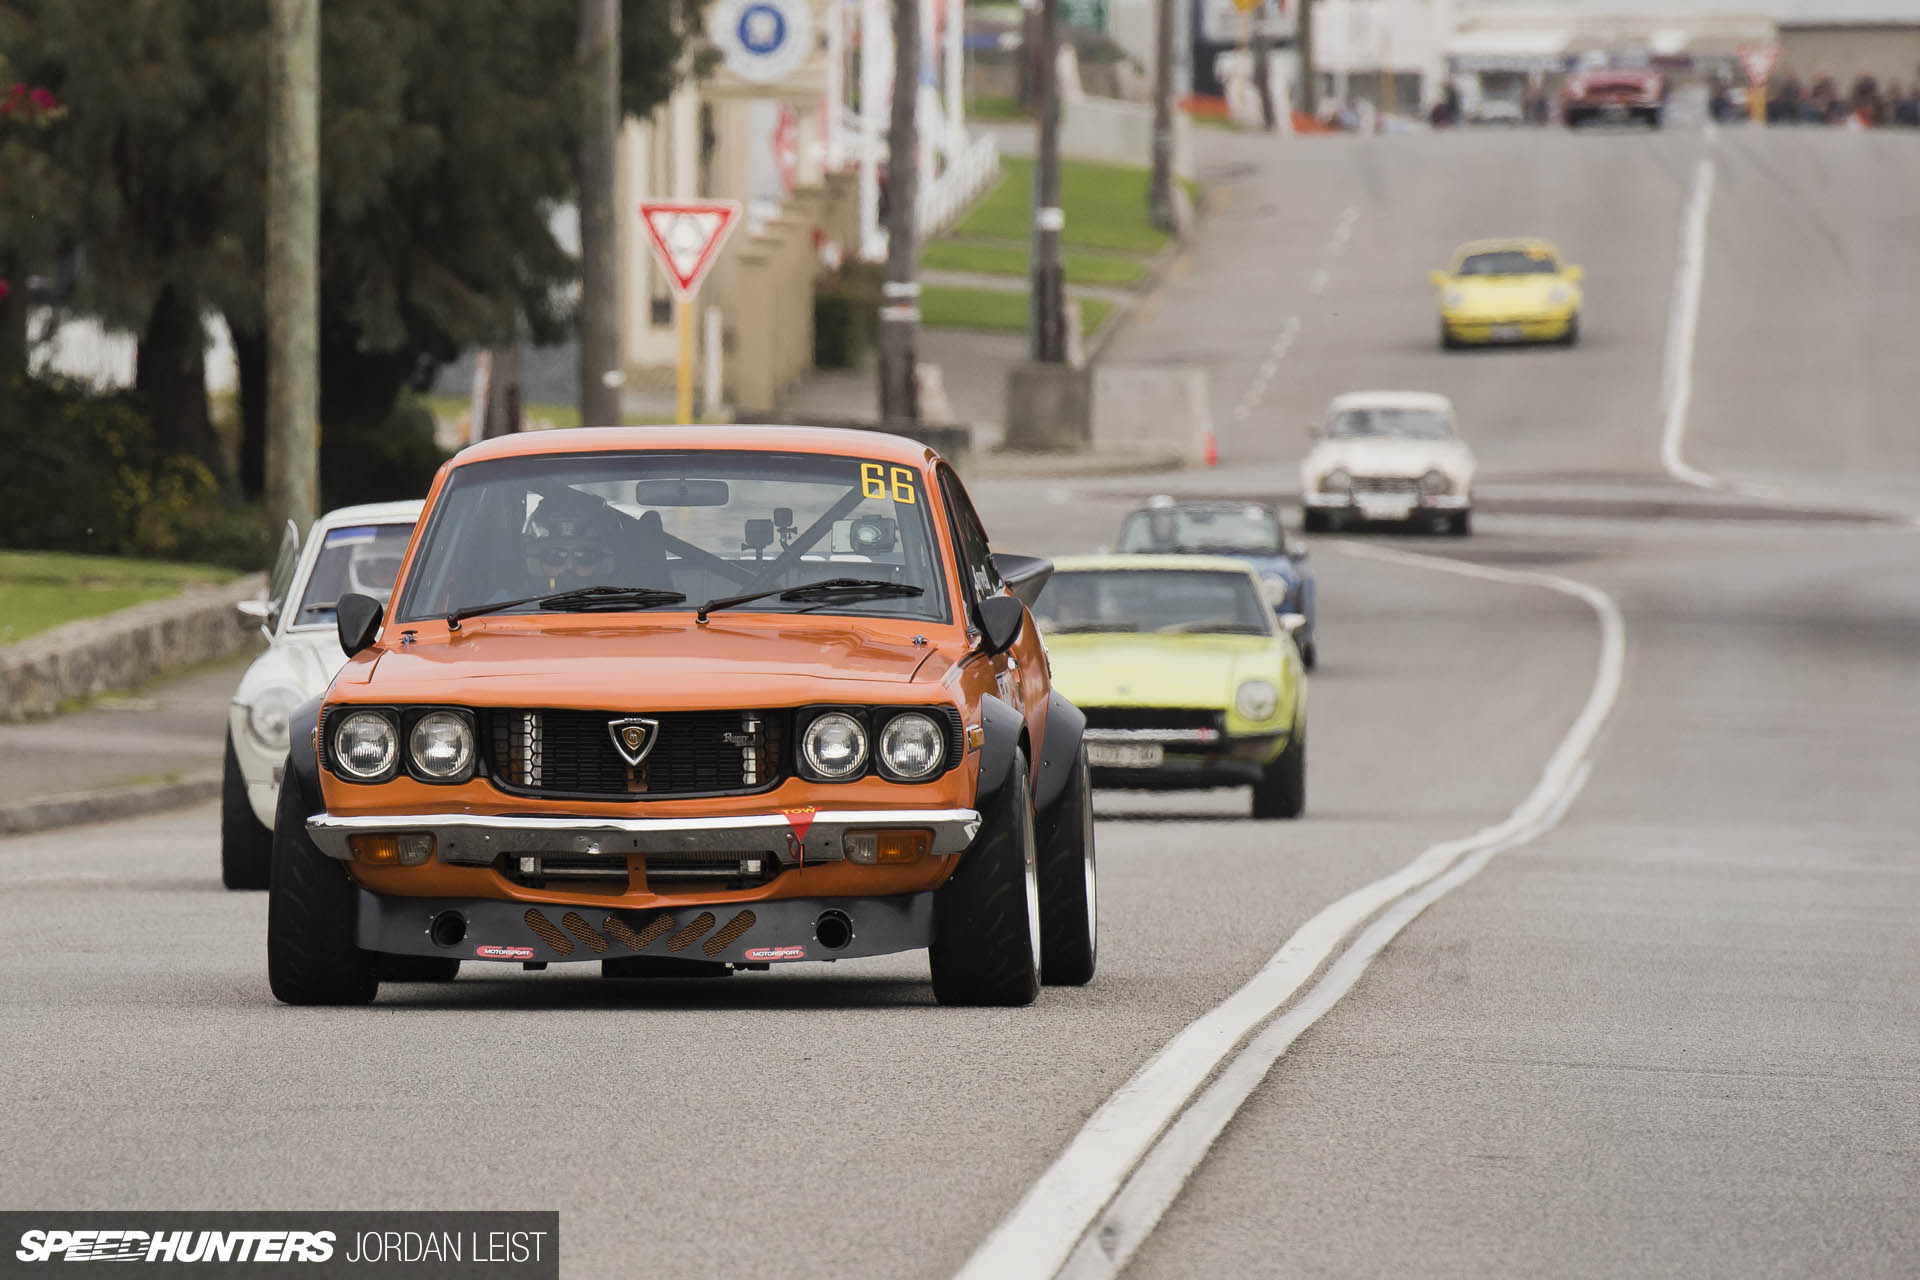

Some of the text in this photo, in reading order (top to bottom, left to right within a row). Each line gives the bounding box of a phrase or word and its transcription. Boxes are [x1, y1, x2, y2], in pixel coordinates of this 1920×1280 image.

[861, 463, 915, 505] 66
[783, 807, 816, 815] TOW
[484, 948, 530, 957] MOTORSPORT
[752, 949, 800, 957] MOTORSPORT
